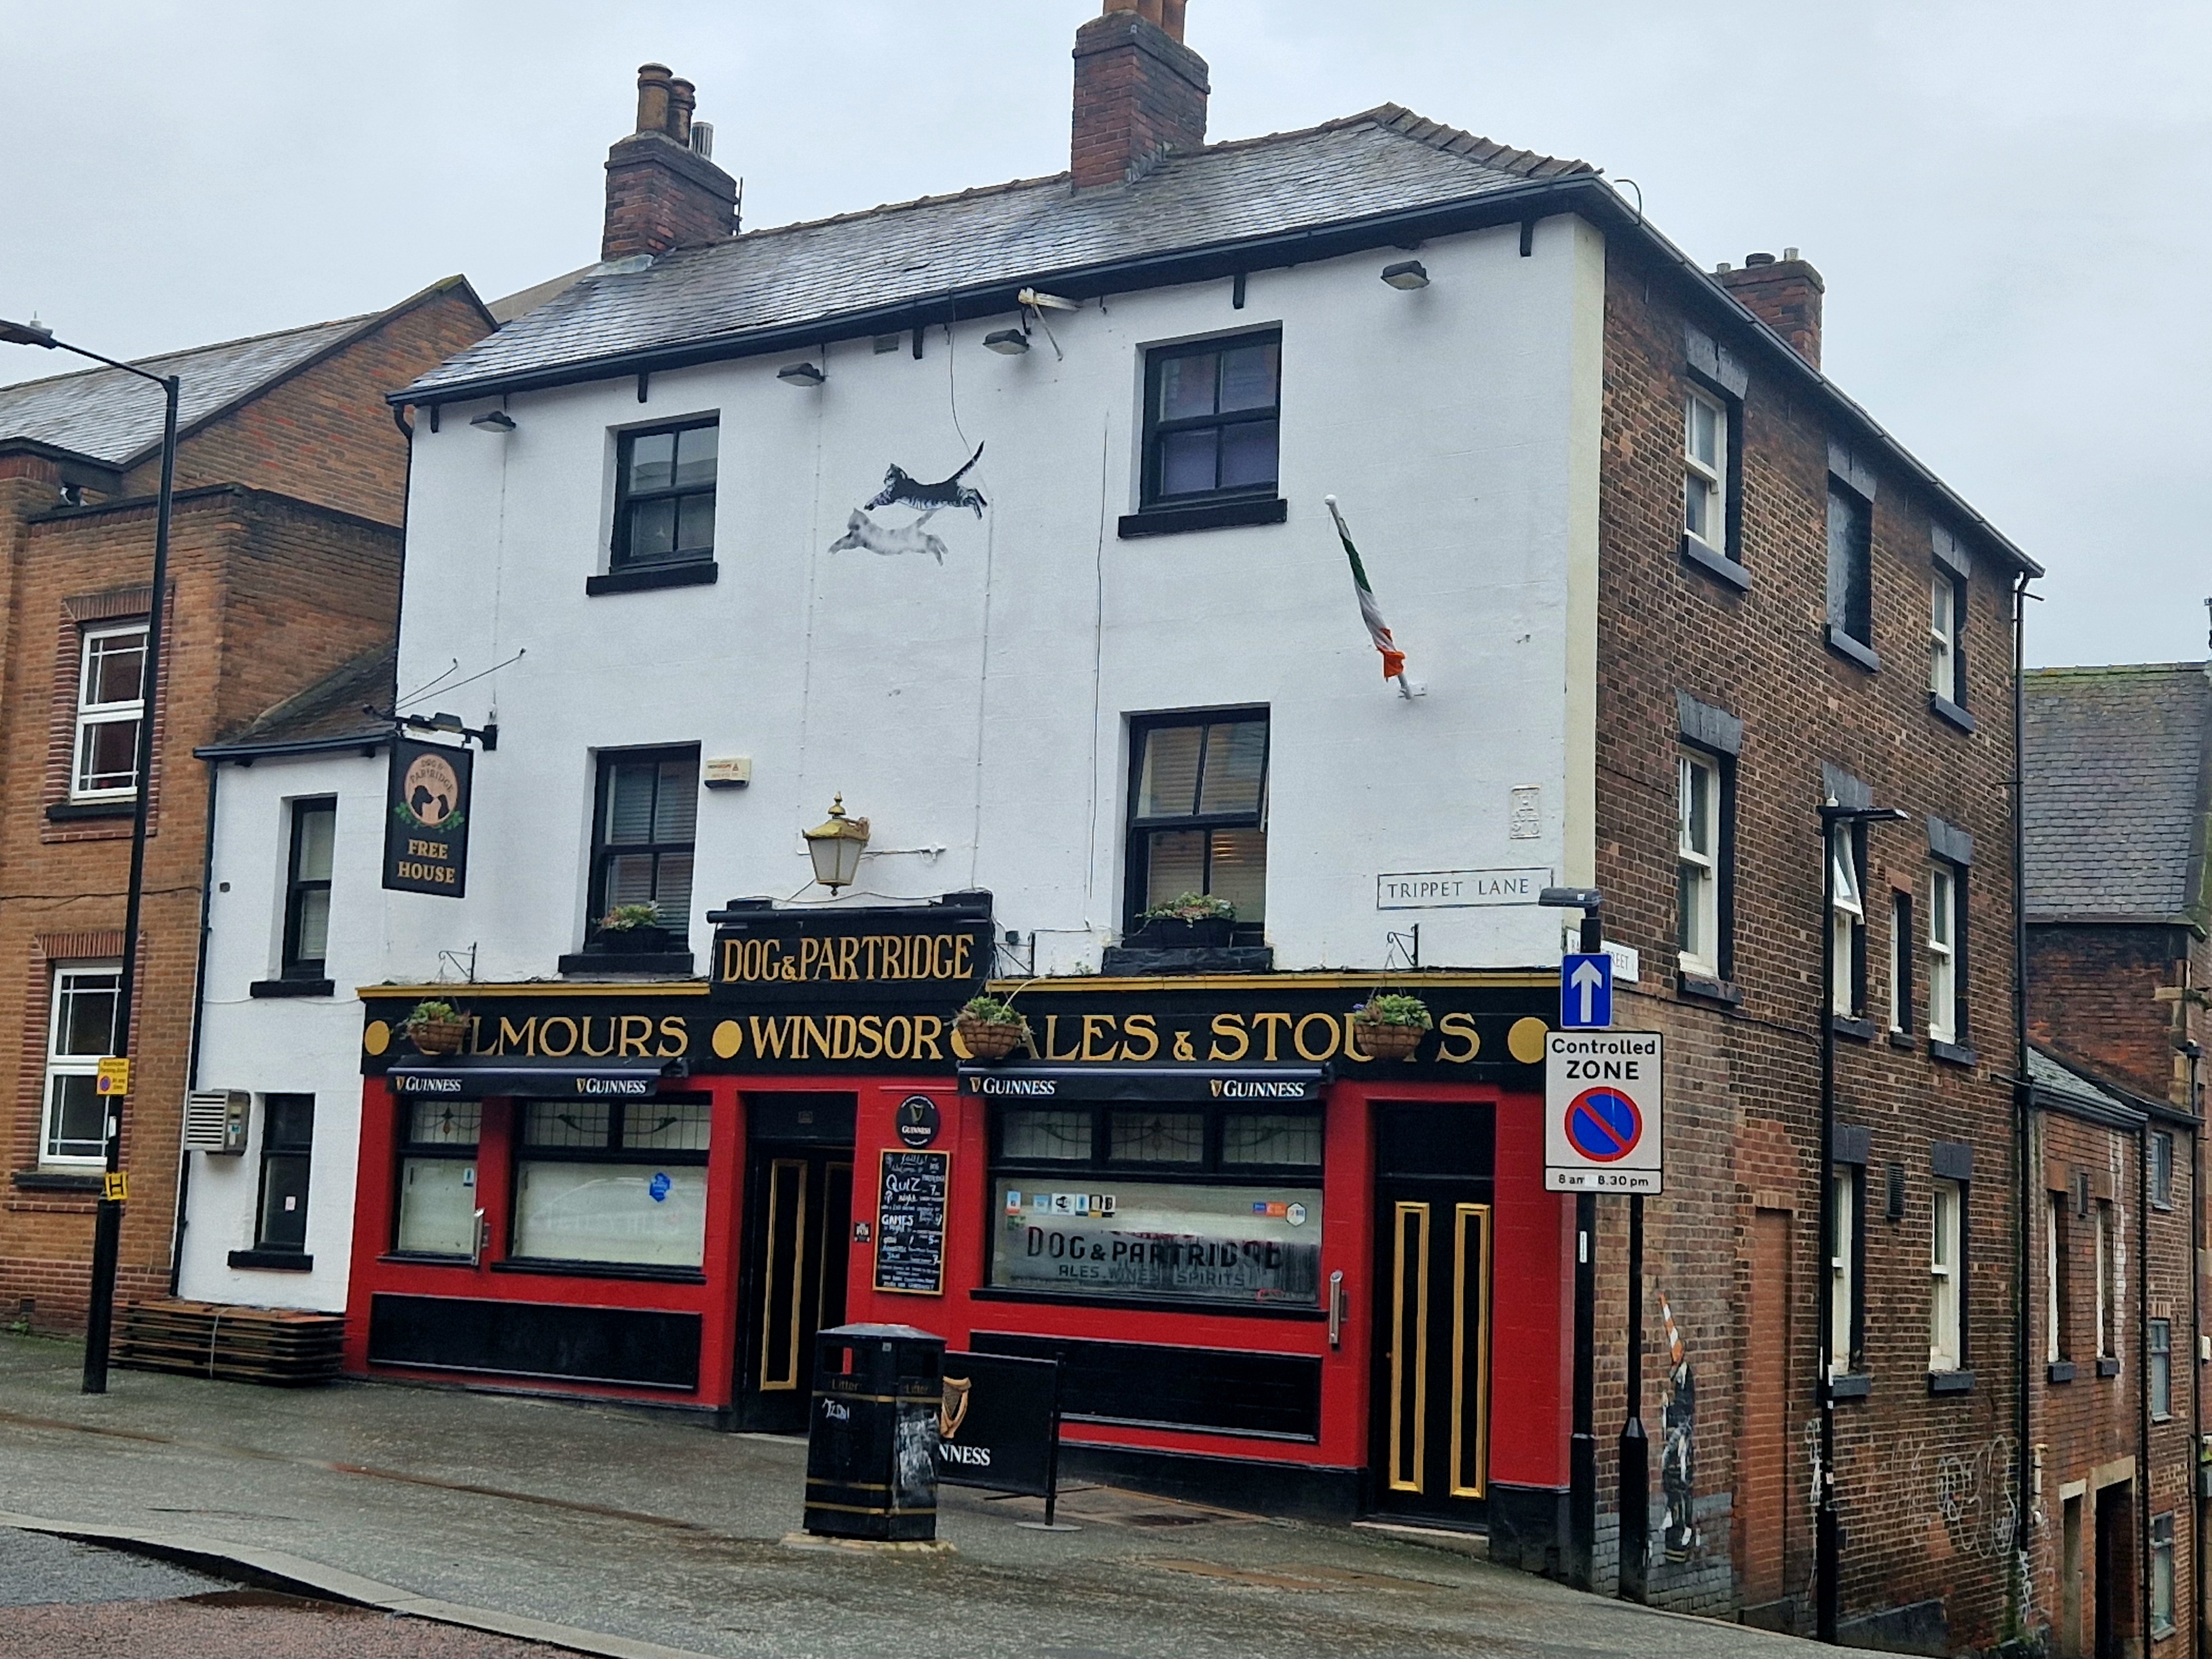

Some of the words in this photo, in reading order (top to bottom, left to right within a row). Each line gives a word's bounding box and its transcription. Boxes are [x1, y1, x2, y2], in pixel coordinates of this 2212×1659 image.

[408, 839, 448, 860] FREE
[397, 861, 456, 884] HOUSE
[1387, 880, 1464, 898] TRIPPET
[1478, 878, 1529, 895] LANE
[419, 1016, 689, 1057] LMOURS
[748, 1015, 944, 1060] WINDSOR
[1173, 1031, 1197, 1061] &
[1208, 1012, 1481, 1063] STOUS
[1552, 1038, 1655, 1054] Controlled
[1566, 1060, 1639, 1080] ZONE
[405, 1076, 462, 1093] GUINNESS
[585, 1077, 648, 1094] GUINNESS
[983, 1077, 1056, 1095] GUINNESS
[1223, 1079, 1307, 1098] GUINNESS
[109, 1173, 124, 1197] H
[1558, 1174, 1566, 1184] 8
[1597, 1175, 1627, 1186] 8.30
[1630, 1178, 1649, 1188] pm
[832, 1378, 859, 1392] Litter
[904, 1383, 929, 1395] Litter
[939, 1443, 991, 1466] NNESS
